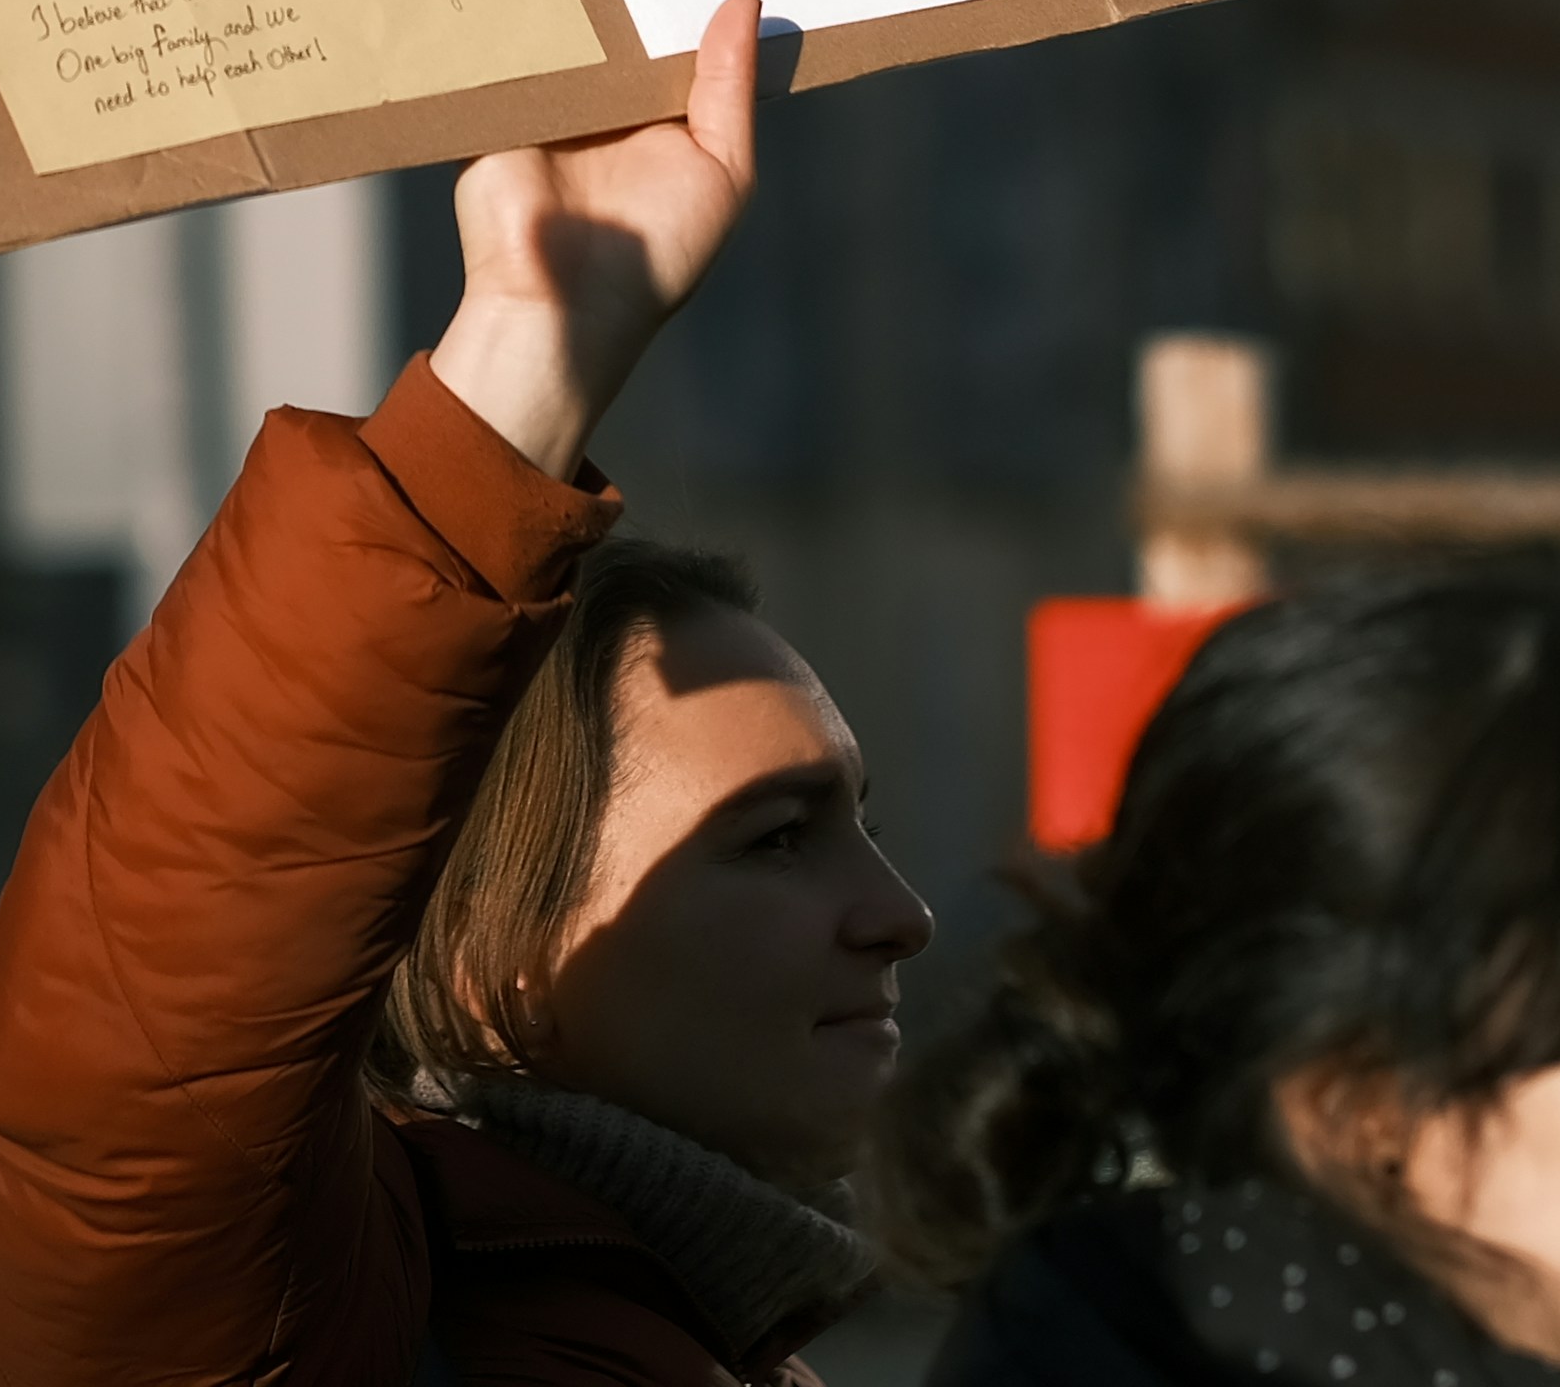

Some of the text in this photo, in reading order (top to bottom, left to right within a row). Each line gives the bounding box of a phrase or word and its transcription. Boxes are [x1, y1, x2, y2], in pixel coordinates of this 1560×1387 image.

[31, 4, 50, 41] I
[53, 2, 125, 34] believe
[56, 48, 109, 83] One
[112, 45, 148, 76] big
[224, 5, 259, 36] and
[94, 83, 135, 114] need
[145, 79, 169, 97] to
[176, 67, 217, 96] help
[224, 50, 263, 79] each
